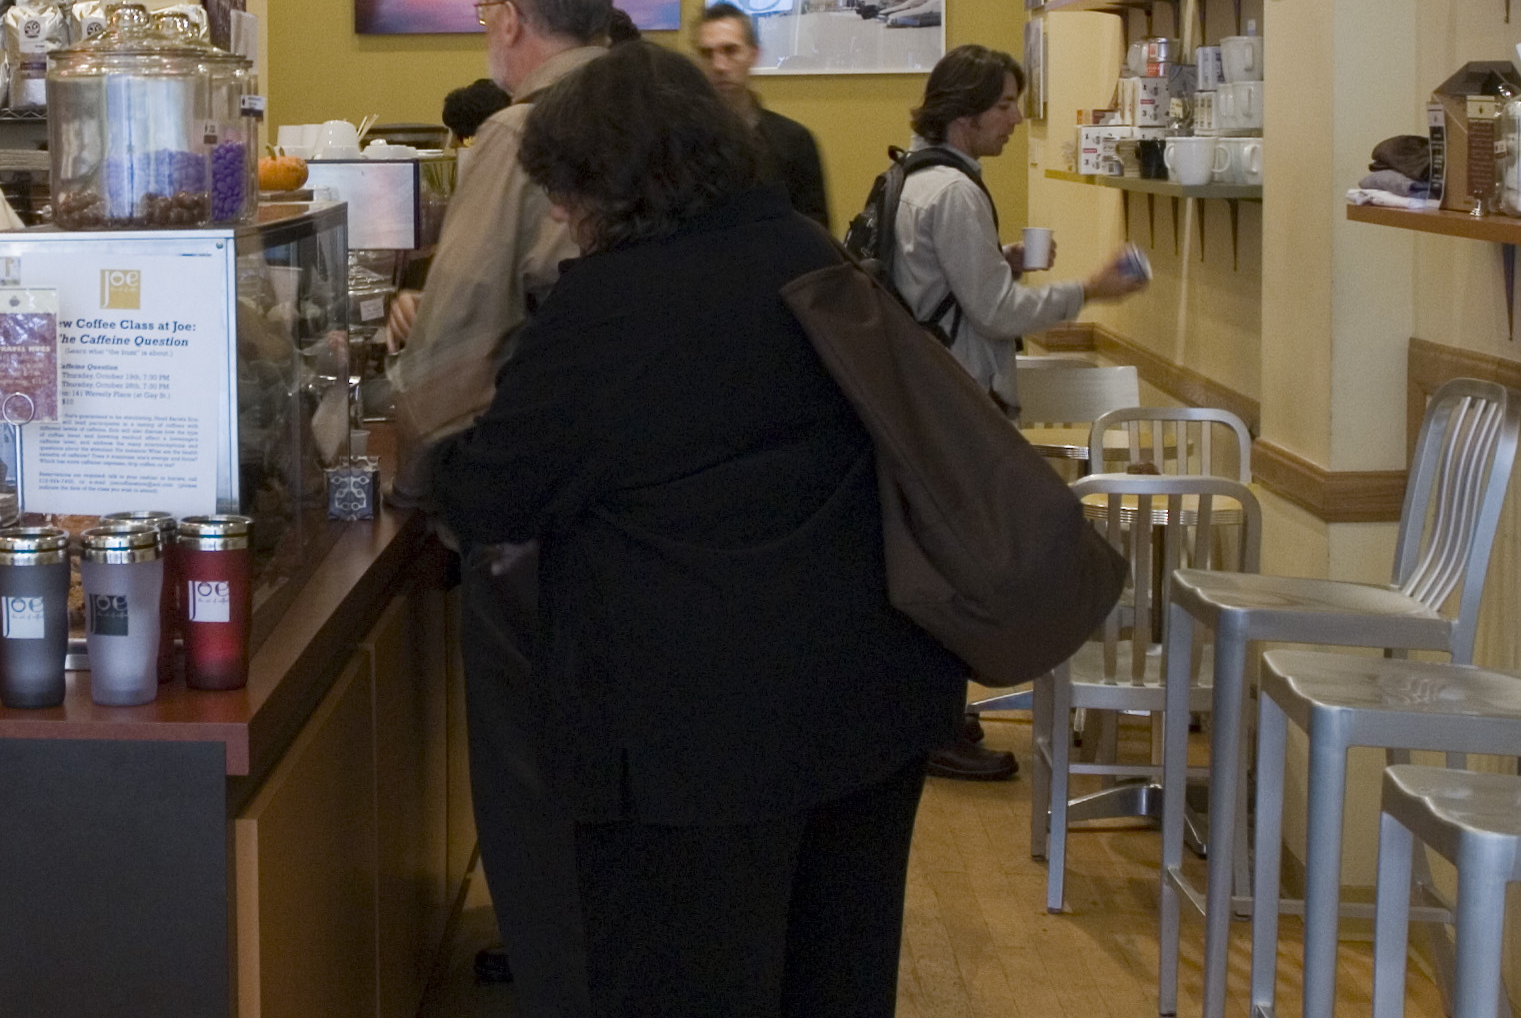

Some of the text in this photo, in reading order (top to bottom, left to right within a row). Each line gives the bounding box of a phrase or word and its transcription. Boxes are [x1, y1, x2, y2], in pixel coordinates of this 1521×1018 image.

[76, 318, 196, 333] Coffee Class at Joe:
[60, 334, 188, 347] he Caffeine Question
